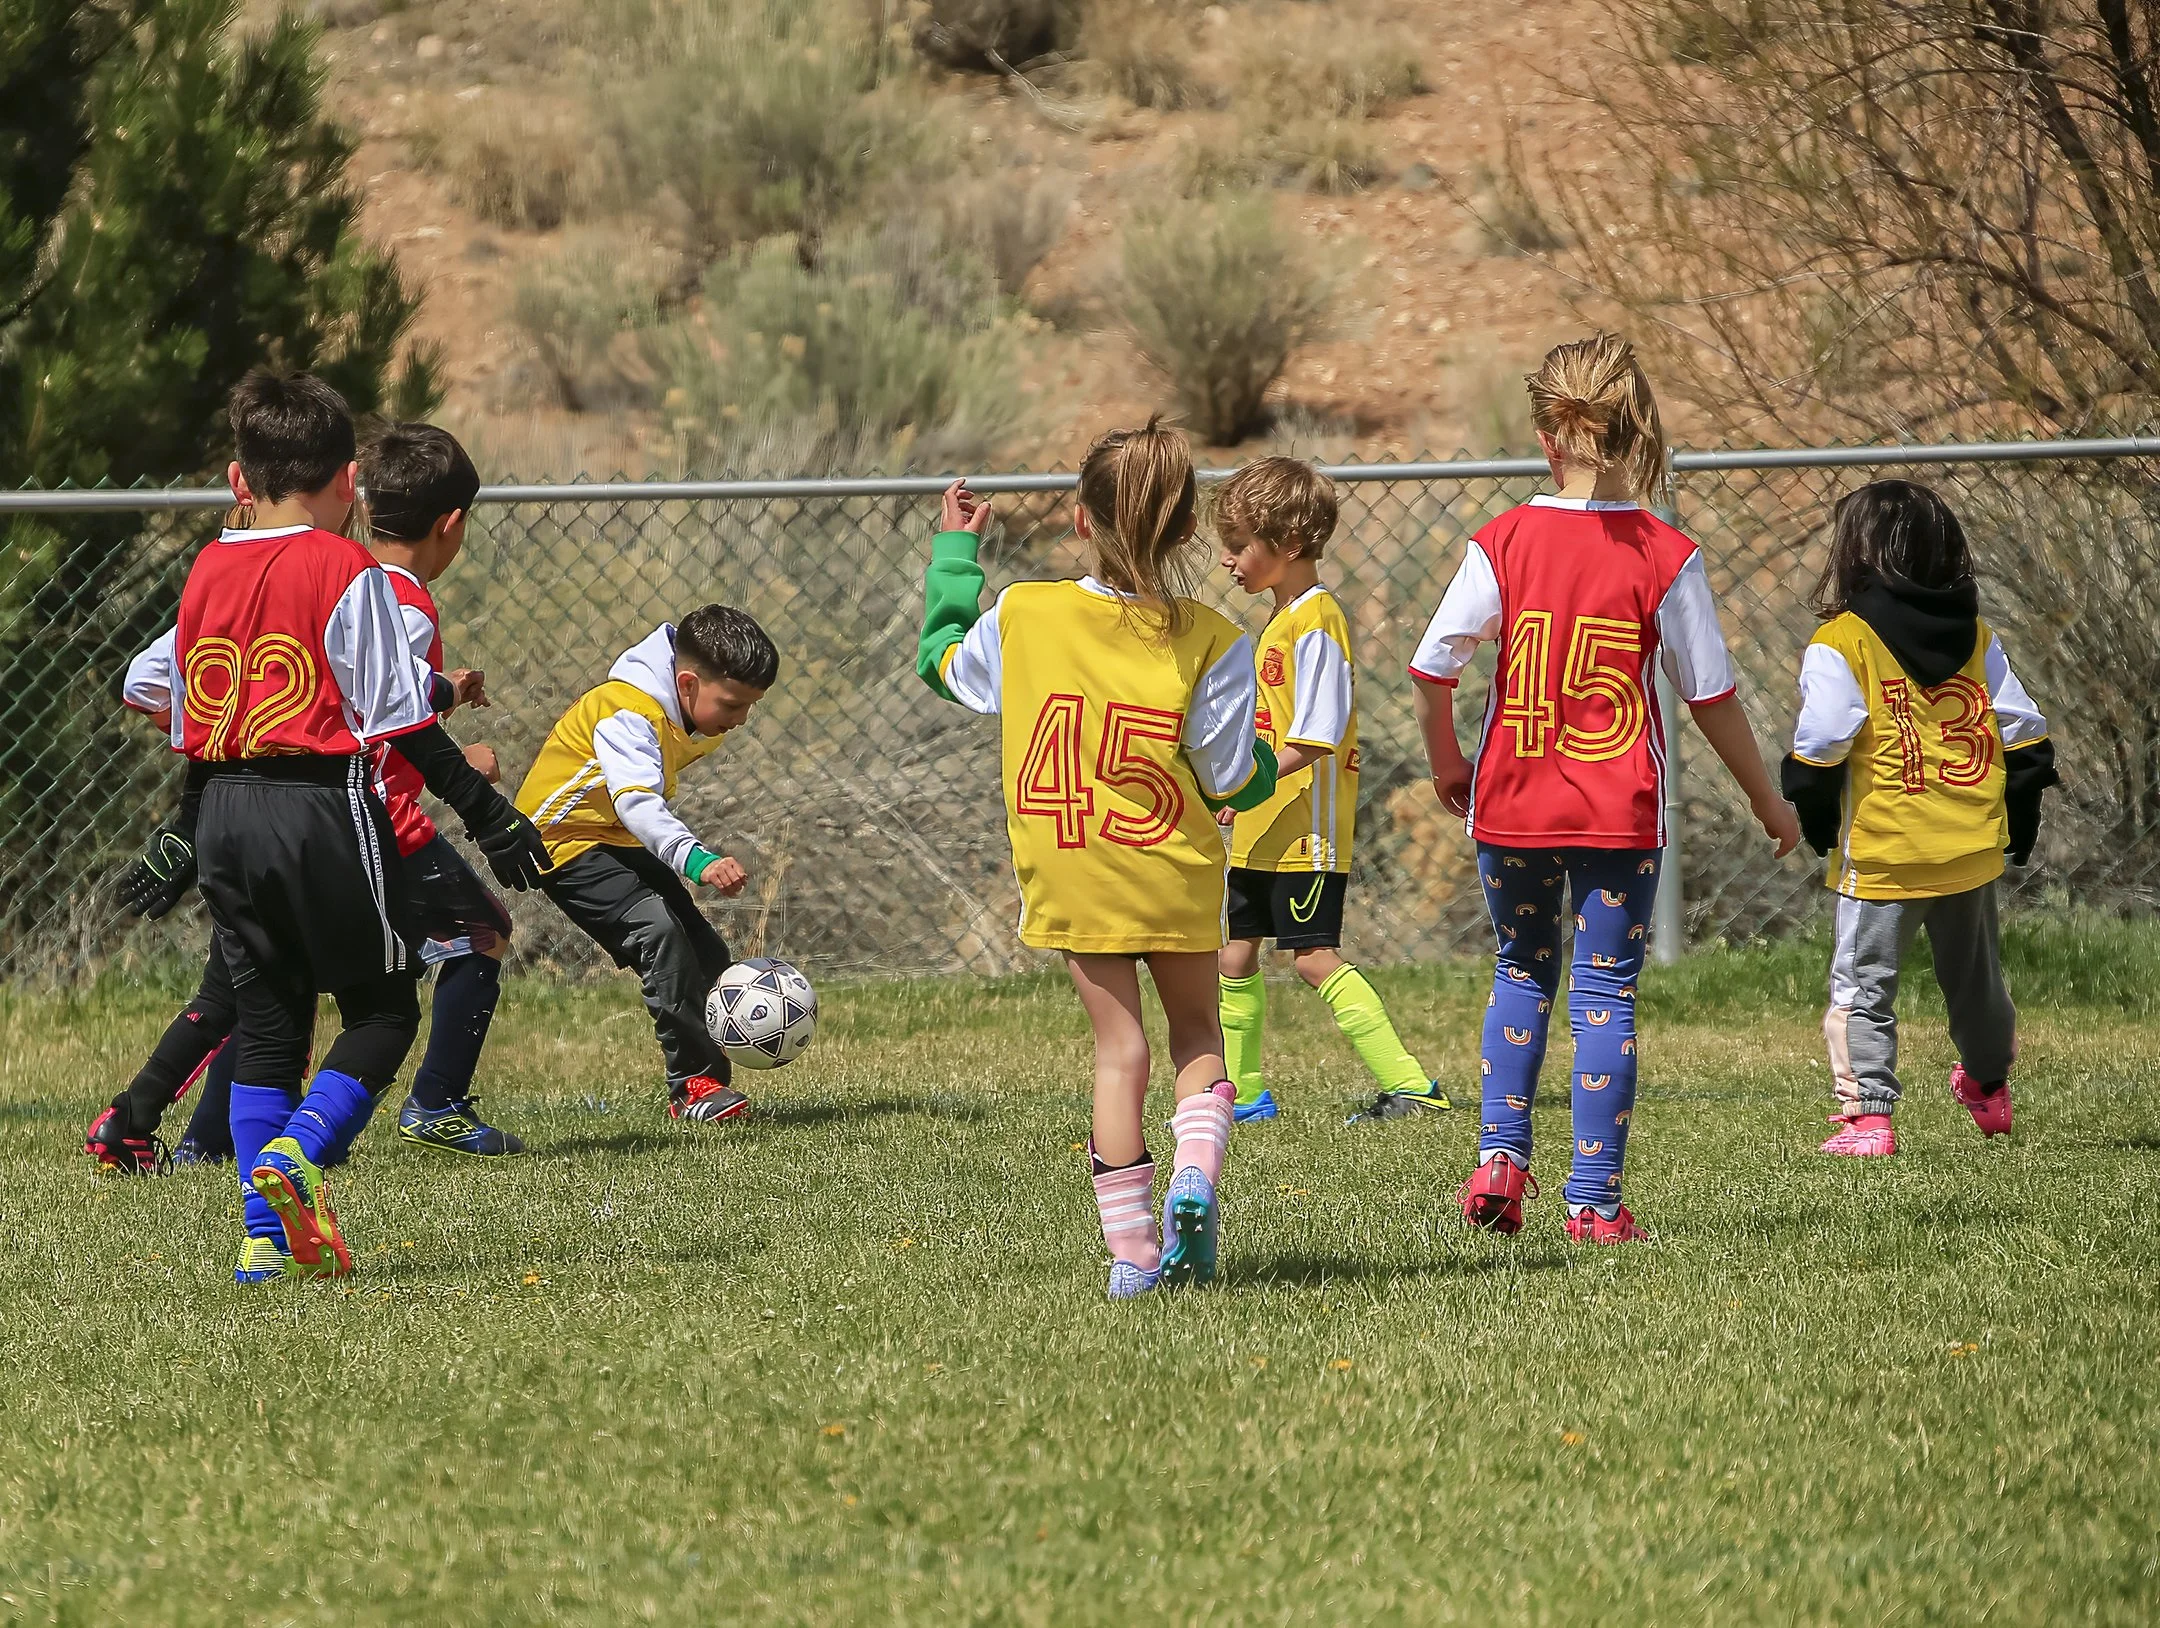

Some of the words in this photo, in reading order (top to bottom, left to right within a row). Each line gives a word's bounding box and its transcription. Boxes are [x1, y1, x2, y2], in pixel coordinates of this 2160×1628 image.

[184, 633, 317, 762] 92
[1502, 610, 1648, 762] 45
[1881, 673, 1995, 794] 13
[1017, 693, 1184, 849] 45
